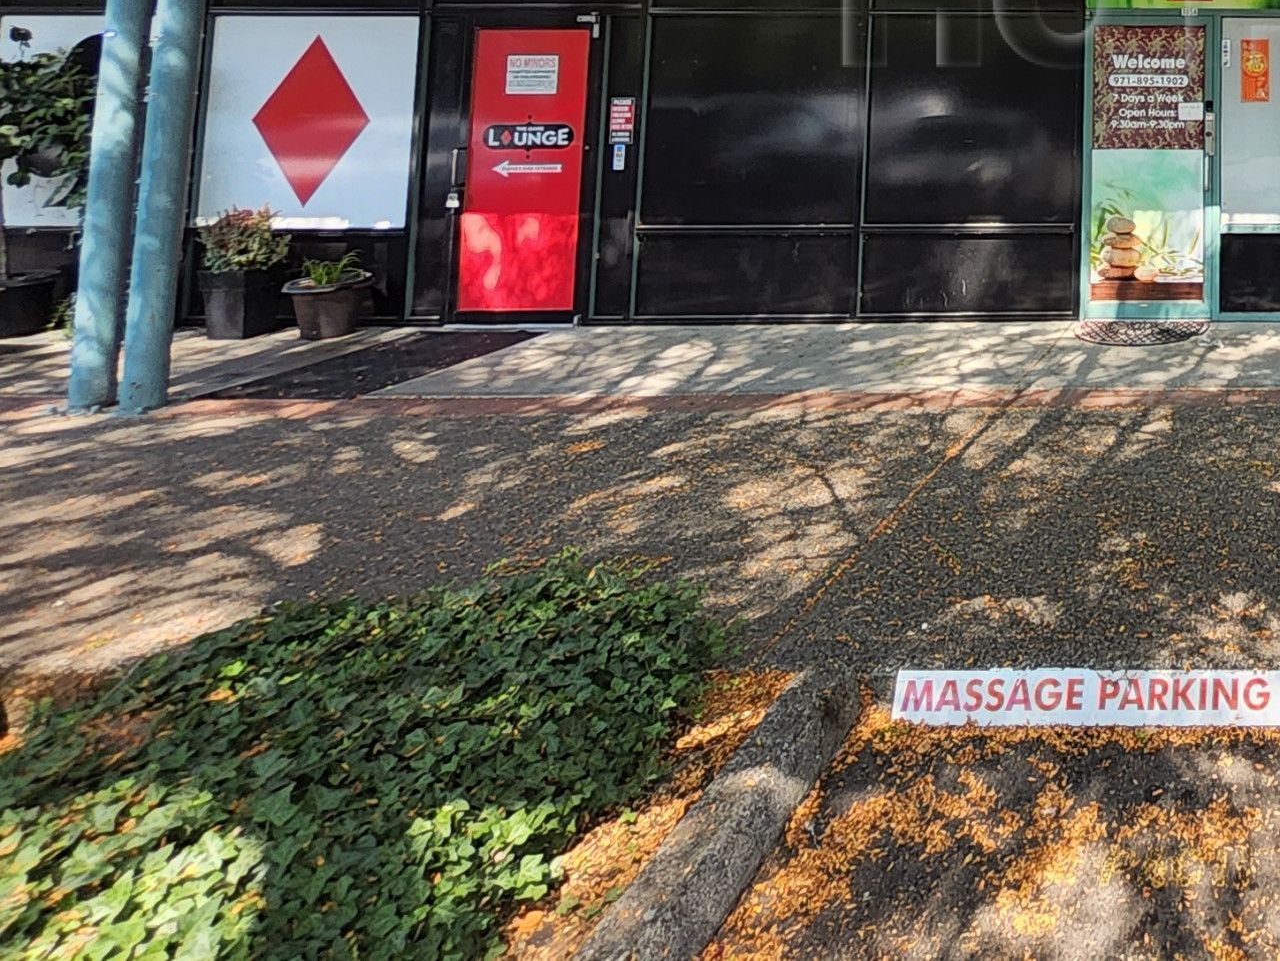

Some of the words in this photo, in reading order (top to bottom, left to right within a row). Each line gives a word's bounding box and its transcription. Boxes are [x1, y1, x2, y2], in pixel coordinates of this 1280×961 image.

[1112, 55, 1186, 69] Welcome
[1113, 76, 1185, 85] 971-895-1902
[1113, 94, 1119, 102] 7
[1120, 94, 1145, 104] Days
[1157, 93, 1184, 102] Week
[1119, 109, 1146, 118] Open
[1148, 109, 1177, 117] Hours:
[900, 678, 1085, 712] MASSAGE
[1098, 677, 1271, 711] PARKING
